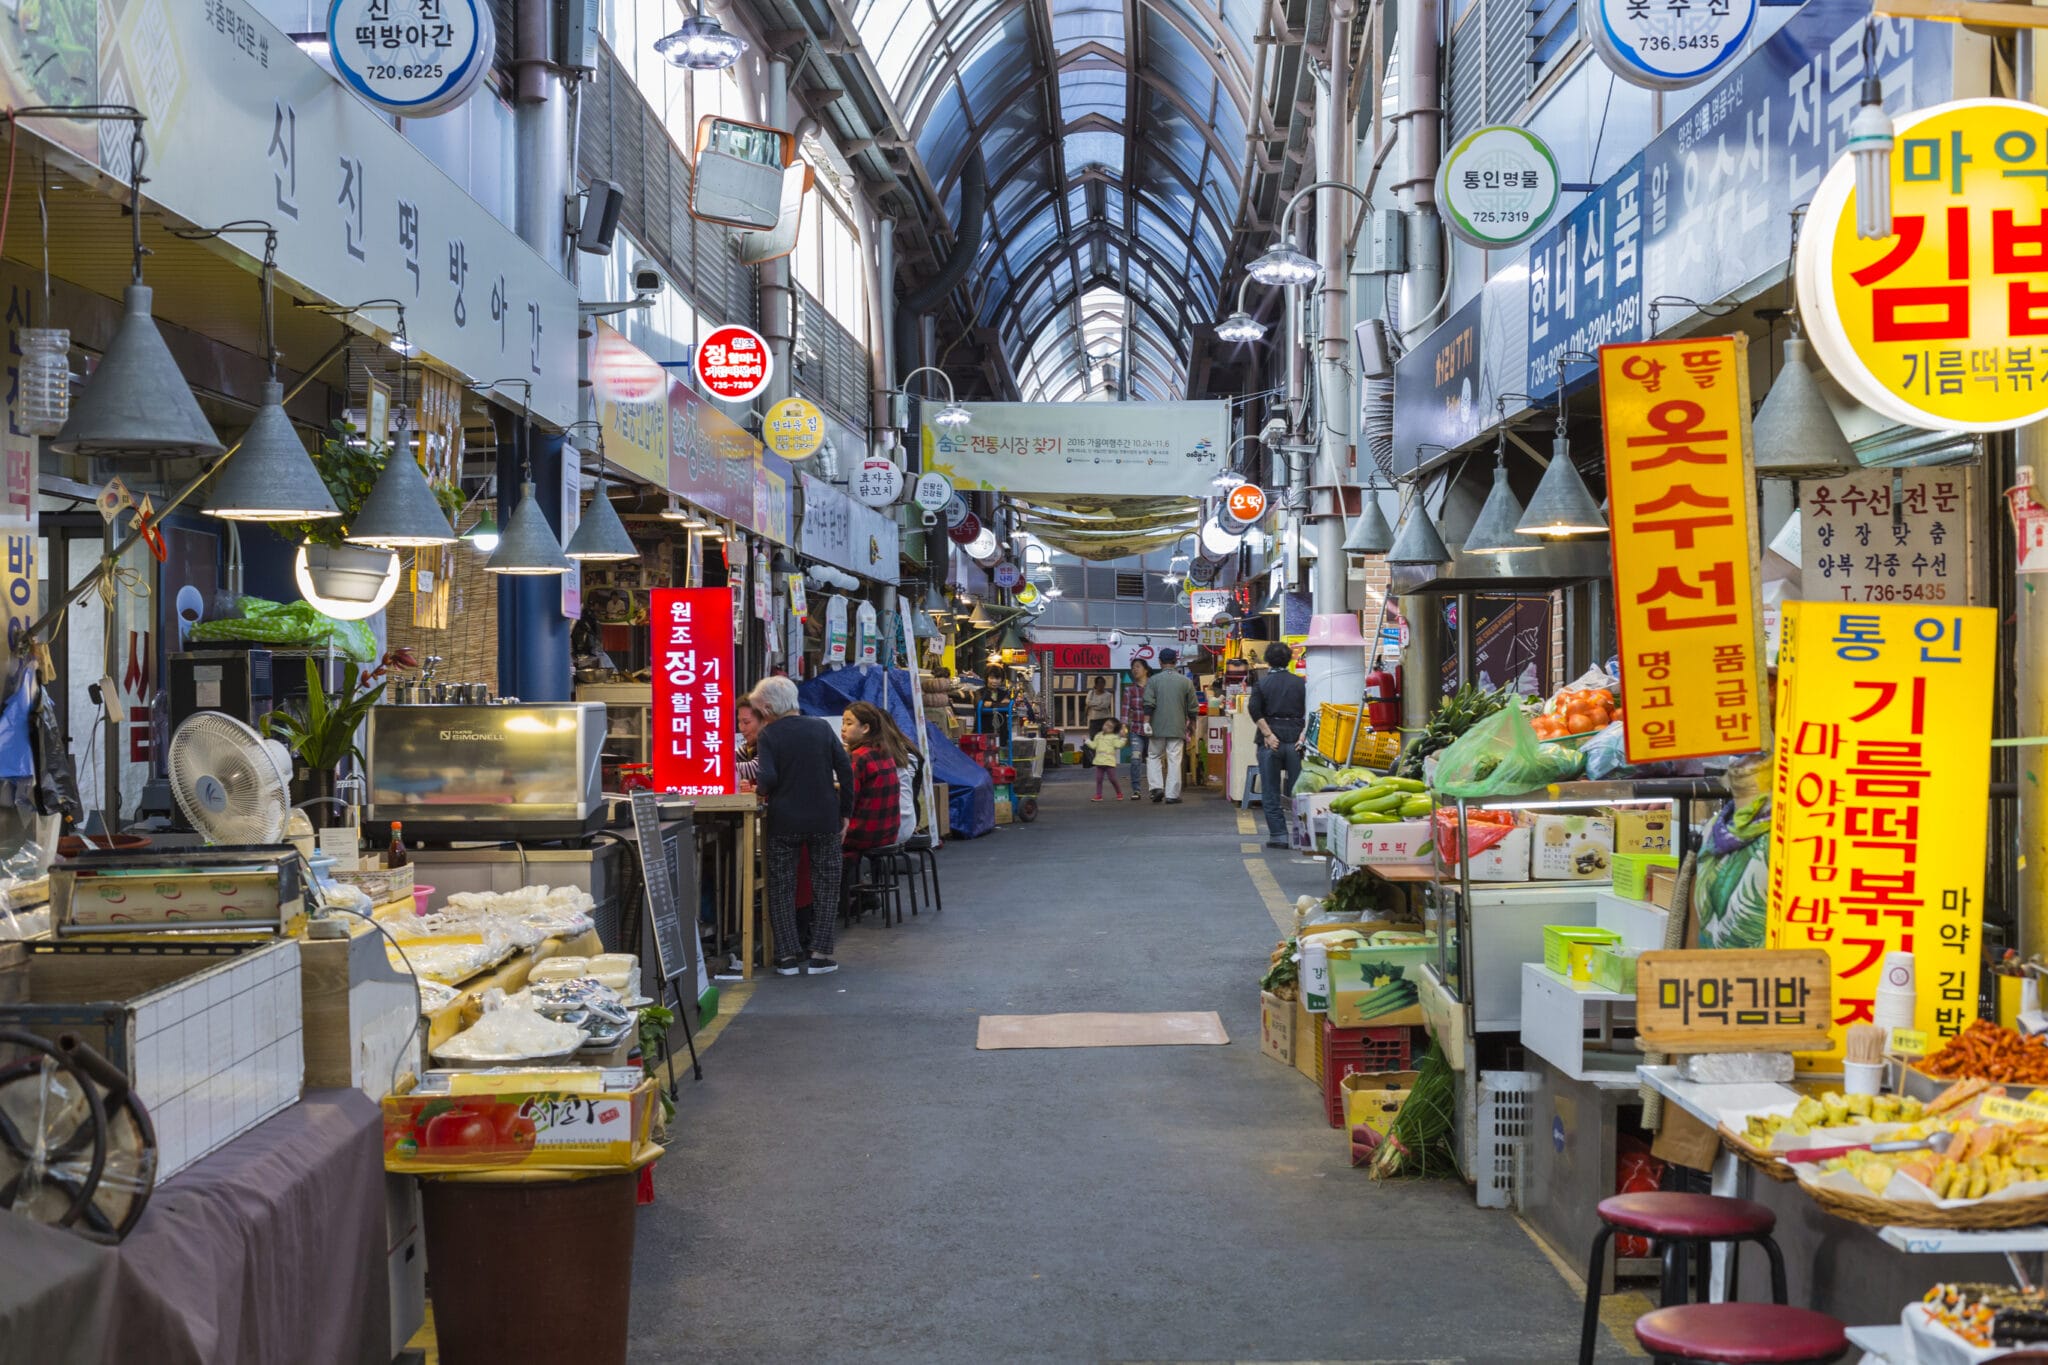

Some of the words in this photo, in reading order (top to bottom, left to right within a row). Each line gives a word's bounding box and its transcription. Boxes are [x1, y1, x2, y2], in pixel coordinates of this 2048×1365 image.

[356, 24, 454, 49] 떡방아간
[1640, 35, 1719, 51] 736.5435
[367, 65, 443, 80] 720.6225
[1463, 171, 1539, 189] 통인명물
[1473, 212, 1529, 223] 725.7319
[1531, 171, 1641, 343] 현대식품
[704, 344, 727, 365] 정
[1621, 349, 1724, 393] 알뜰
[936, 434, 968, 454] 숨은
[971, 434, 1030, 455] 전통시장
[1032, 436, 1062, 455] 찾기
[1067, 438, 1085, 447] 2016
[858, 472, 894, 485] 효자동
[858, 485, 893, 497] 닭꼬치
[1810, 485, 1891, 518] 옷수선
[1902, 482, 1960, 514] 전문
[1231, 493, 1262, 511] 호떡
[1626, 399, 1739, 633] 옷수선
[1818, 554, 1854, 579] 양복
[1864, 553, 1901, 578] 각종
[1911, 552, 1948, 577] 수선
[1864, 584, 1947, 602] 736-5435
[1831, 614, 1963, 664] 통인
[1062, 647, 1105, 668] Coffee
[1659, 976, 1811, 1026] 마약김밥
[519, 1092, 601, 1128] 사과
